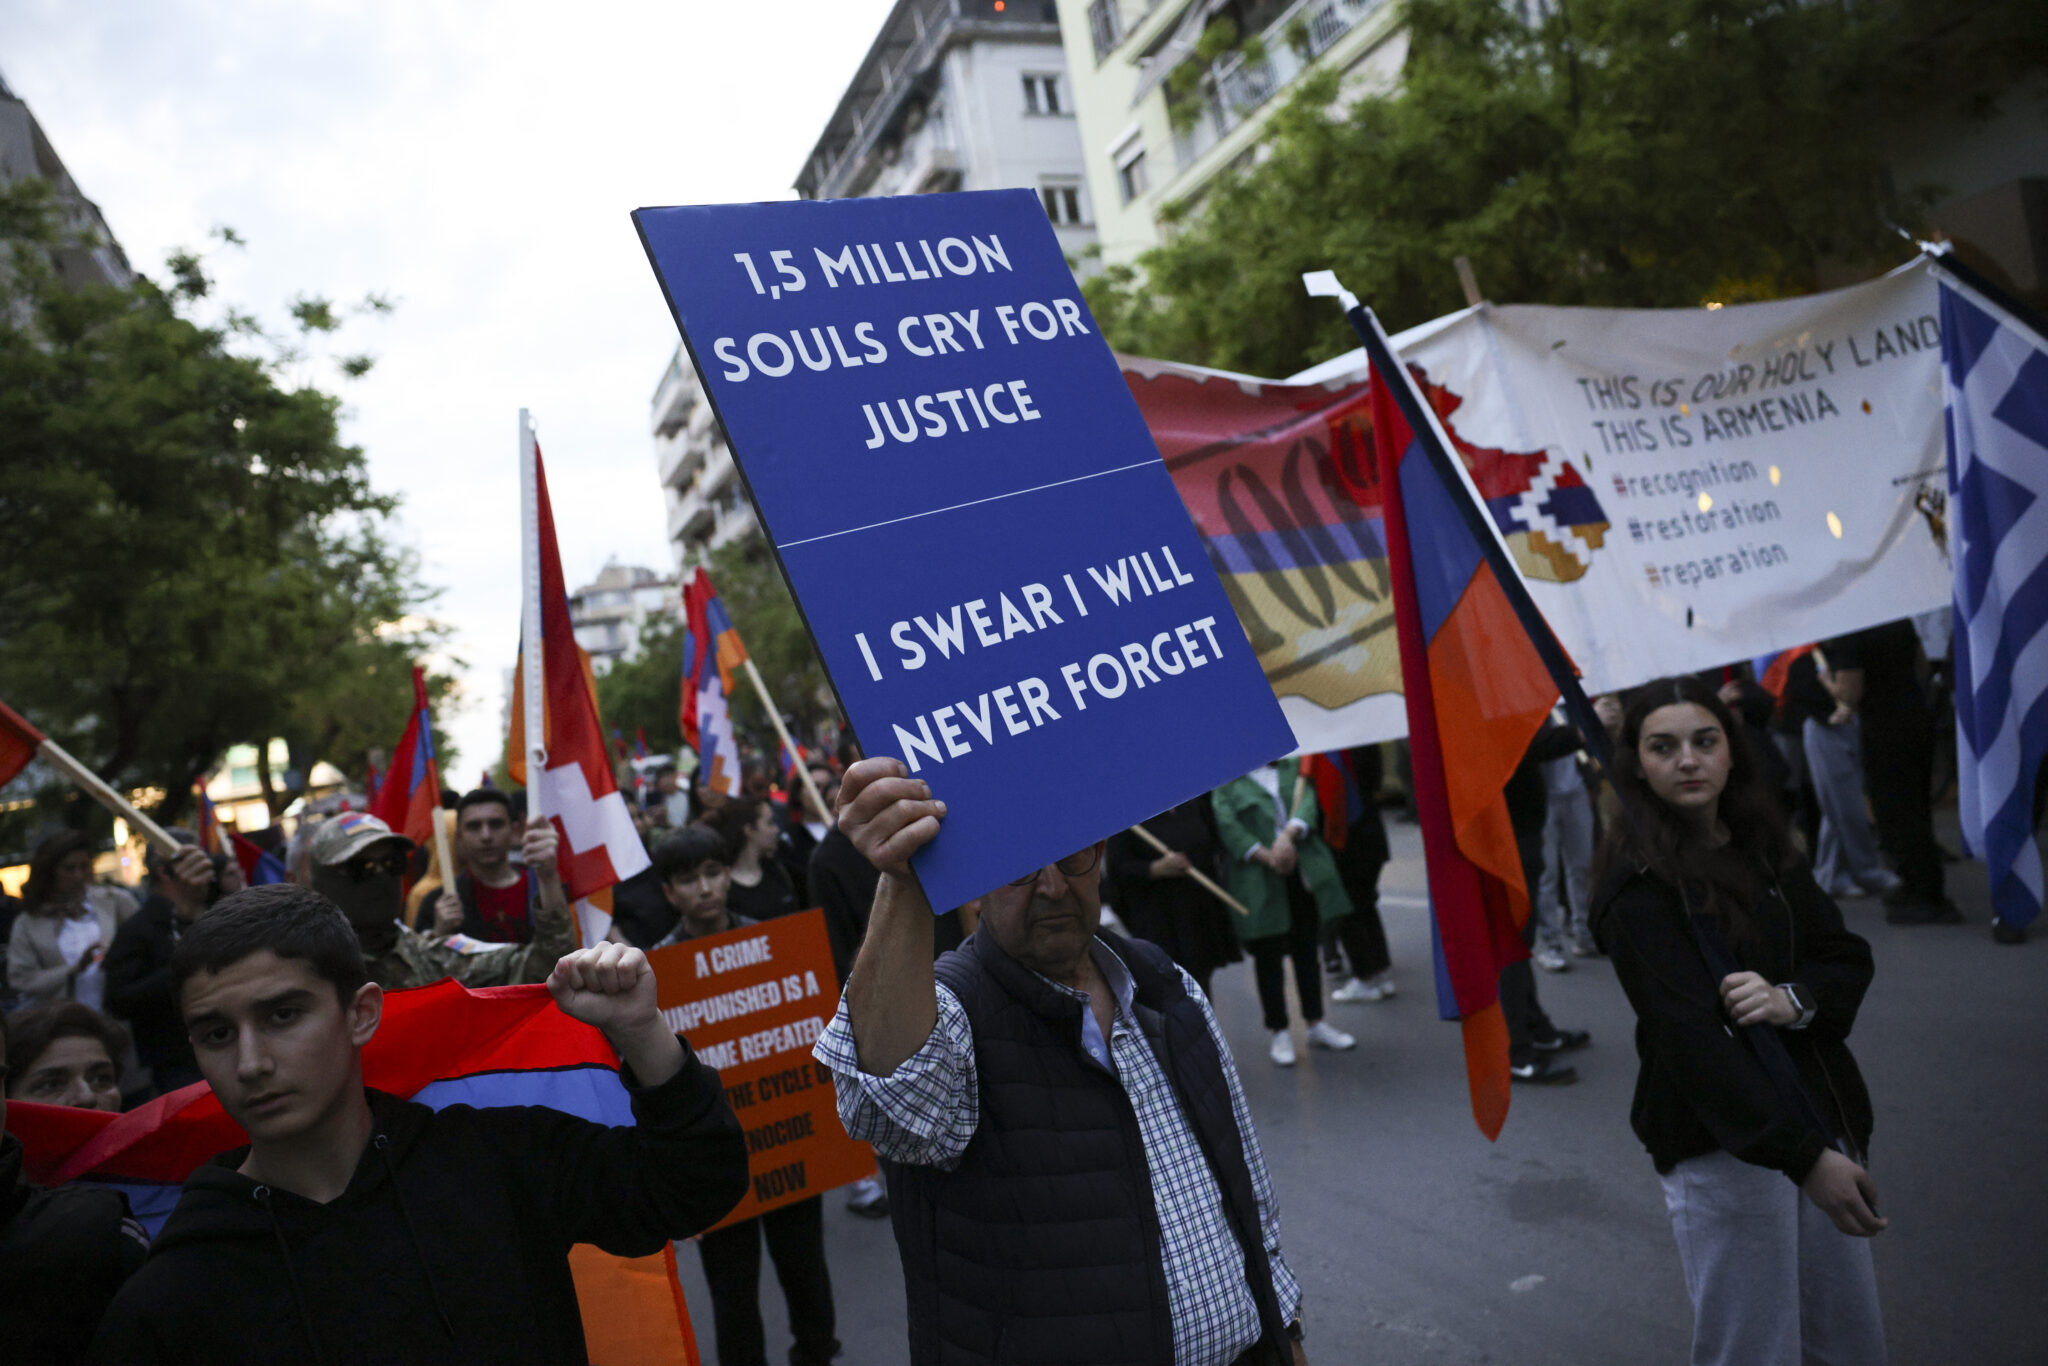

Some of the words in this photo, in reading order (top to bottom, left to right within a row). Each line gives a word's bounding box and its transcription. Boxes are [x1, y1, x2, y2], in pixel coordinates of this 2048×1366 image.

[734, 249, 806, 300] 1,5
[813, 234, 1012, 288] MILLION
[714, 321, 888, 383] SOULS
[898, 309, 985, 358] CRY
[995, 298, 1090, 345] FOR
[1577, 375, 1642, 411] THIS
[1650, 378, 1685, 408] IS
[1691, 362, 1756, 405] OUR
[1762, 343, 1835, 389] HOLY
[1848, 313, 1942, 368] LAND
[862, 380, 1042, 450] JUSTICE
[1592, 418, 1658, 454] THIS
[1660, 413, 1693, 449] IS
[1701, 387, 1841, 443] ARMENIA
[1612, 458, 1758, 499] #recognition
[1628, 499, 1782, 545] #restoration
[1645, 540, 1789, 589] #reparation
[854, 632, 883, 682] I
[890, 582, 1064, 670] SWEAR
[1063, 573, 1089, 617] I
[1086, 545, 1194, 607] WILL
[892, 677, 1062, 773] NEVER
[1060, 616, 1224, 711] FORGET
[694, 952, 711, 979] A
[710, 935, 773, 975] CRIME
[663, 981, 783, 1034] UNPUNISHED
[782, 974, 804, 1004] IS
[804, 970, 821, 998] A
[740, 1016, 825, 1061] REPEATED
[758, 1064, 814, 1102] CYCLE
[753, 1160, 807, 1203] NOW
